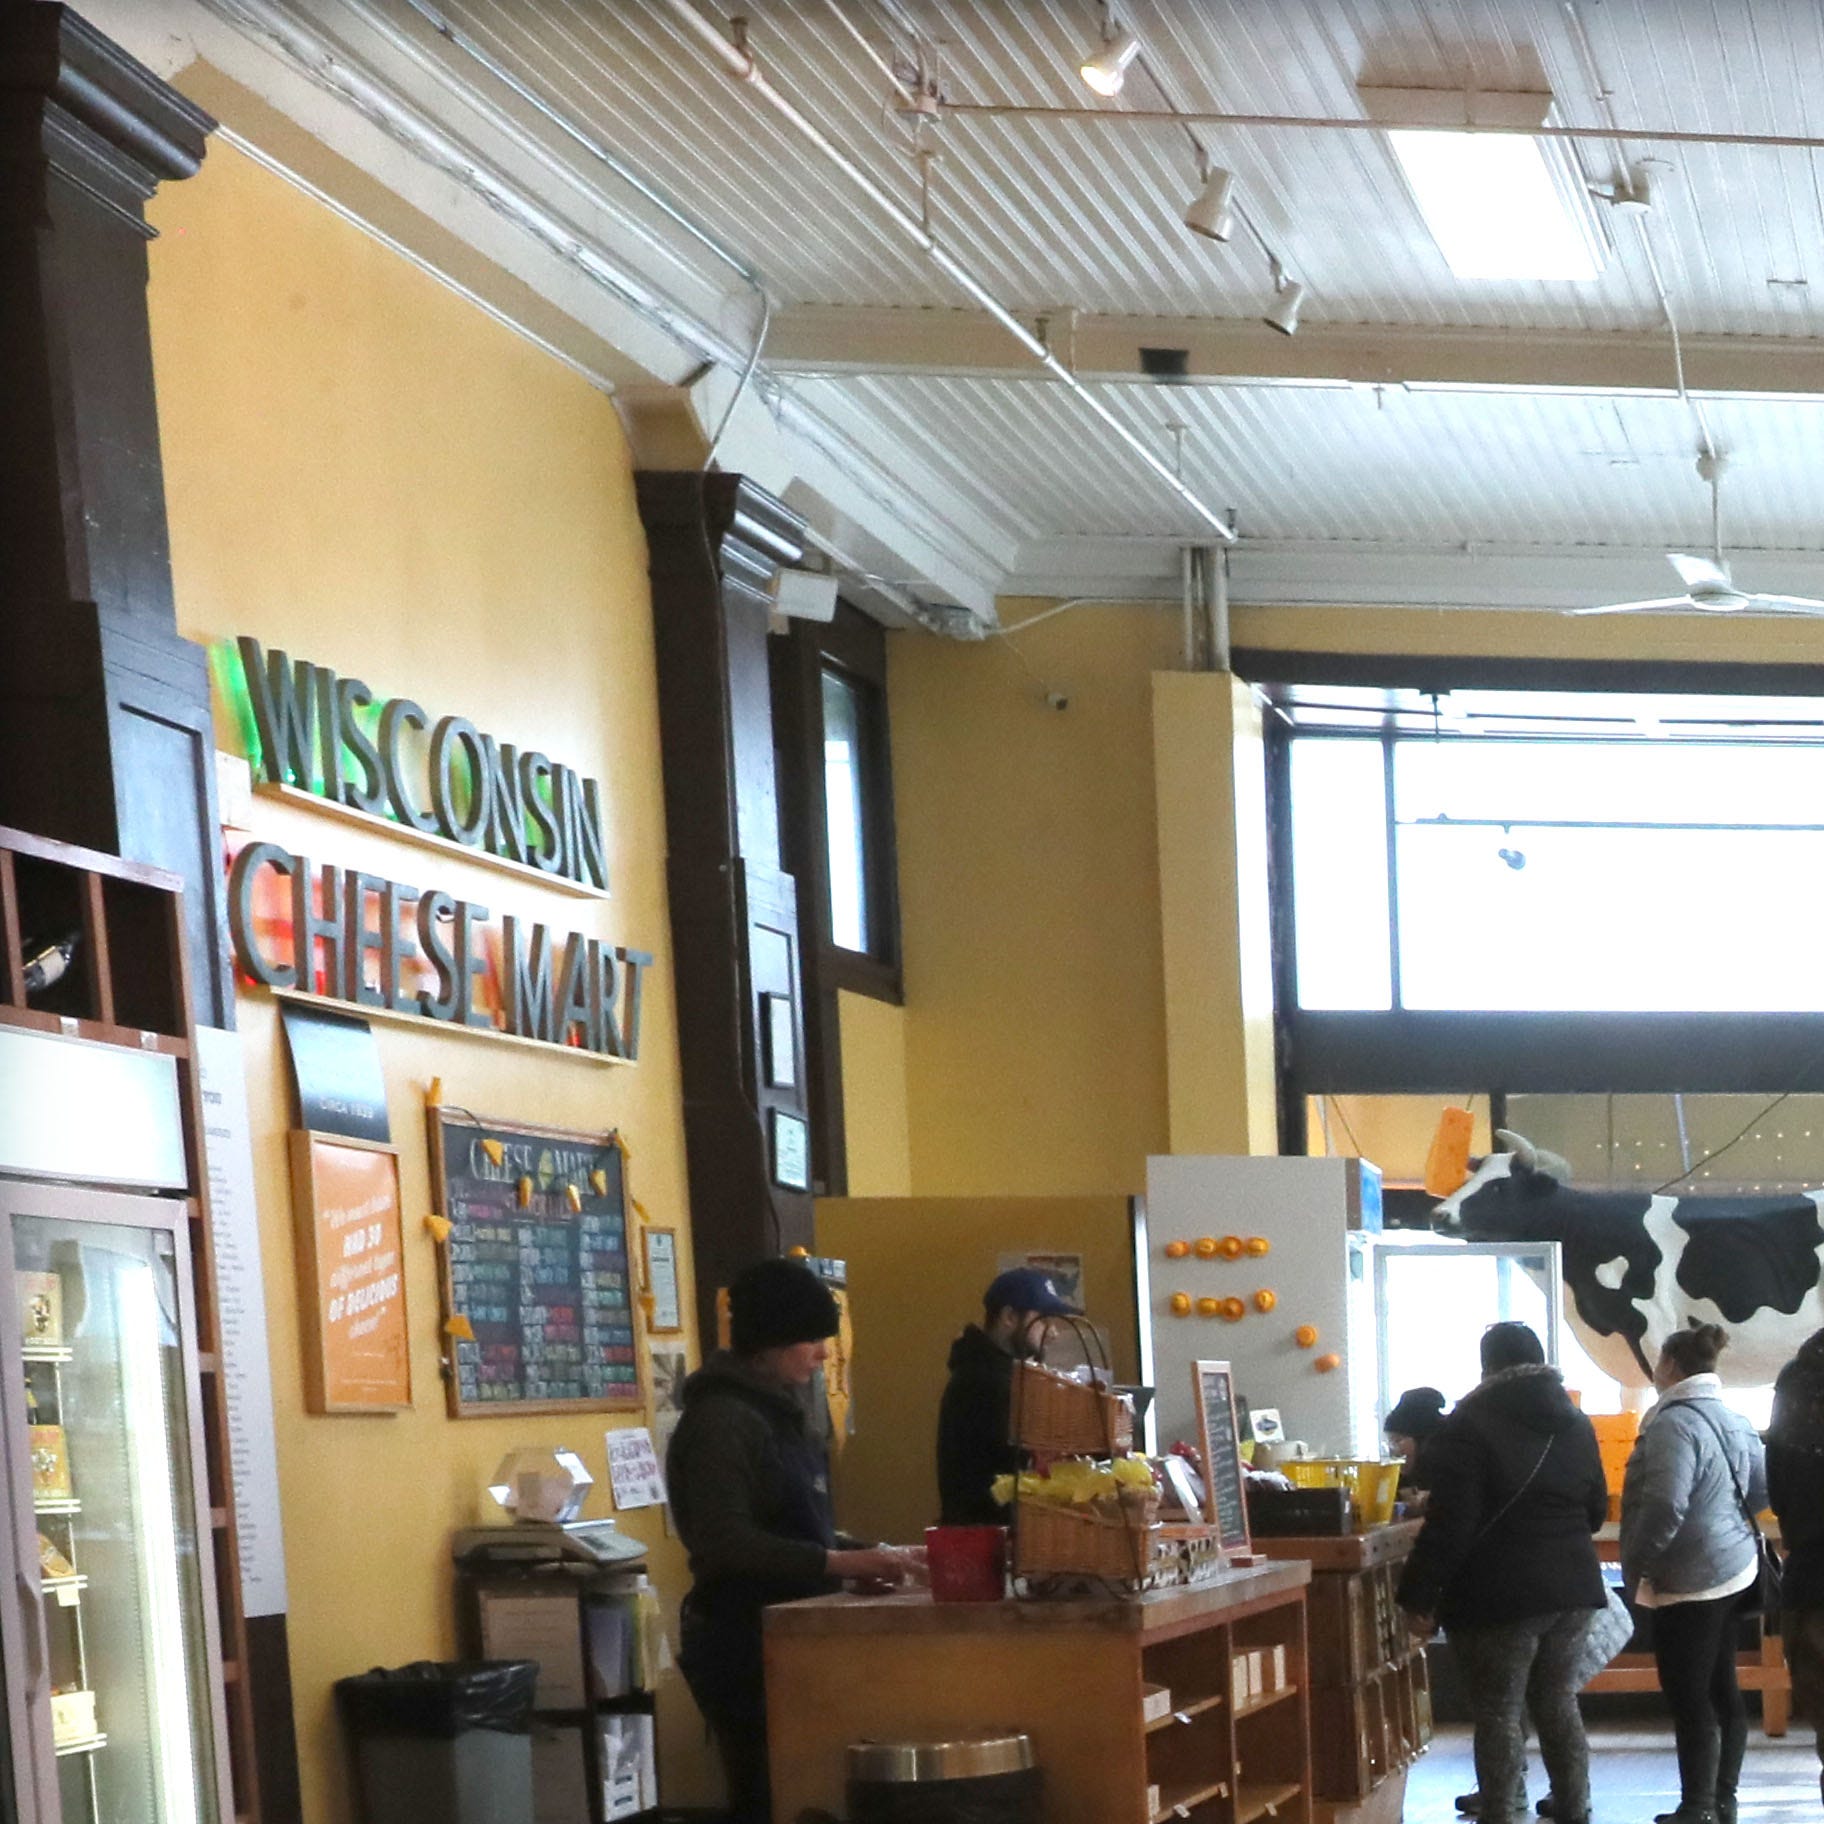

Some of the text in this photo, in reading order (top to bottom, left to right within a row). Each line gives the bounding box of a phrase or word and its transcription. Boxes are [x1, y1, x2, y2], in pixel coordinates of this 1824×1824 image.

[237, 636, 609, 891] WISCONSIN
[229, 842, 654, 1062] CHEESE MART
